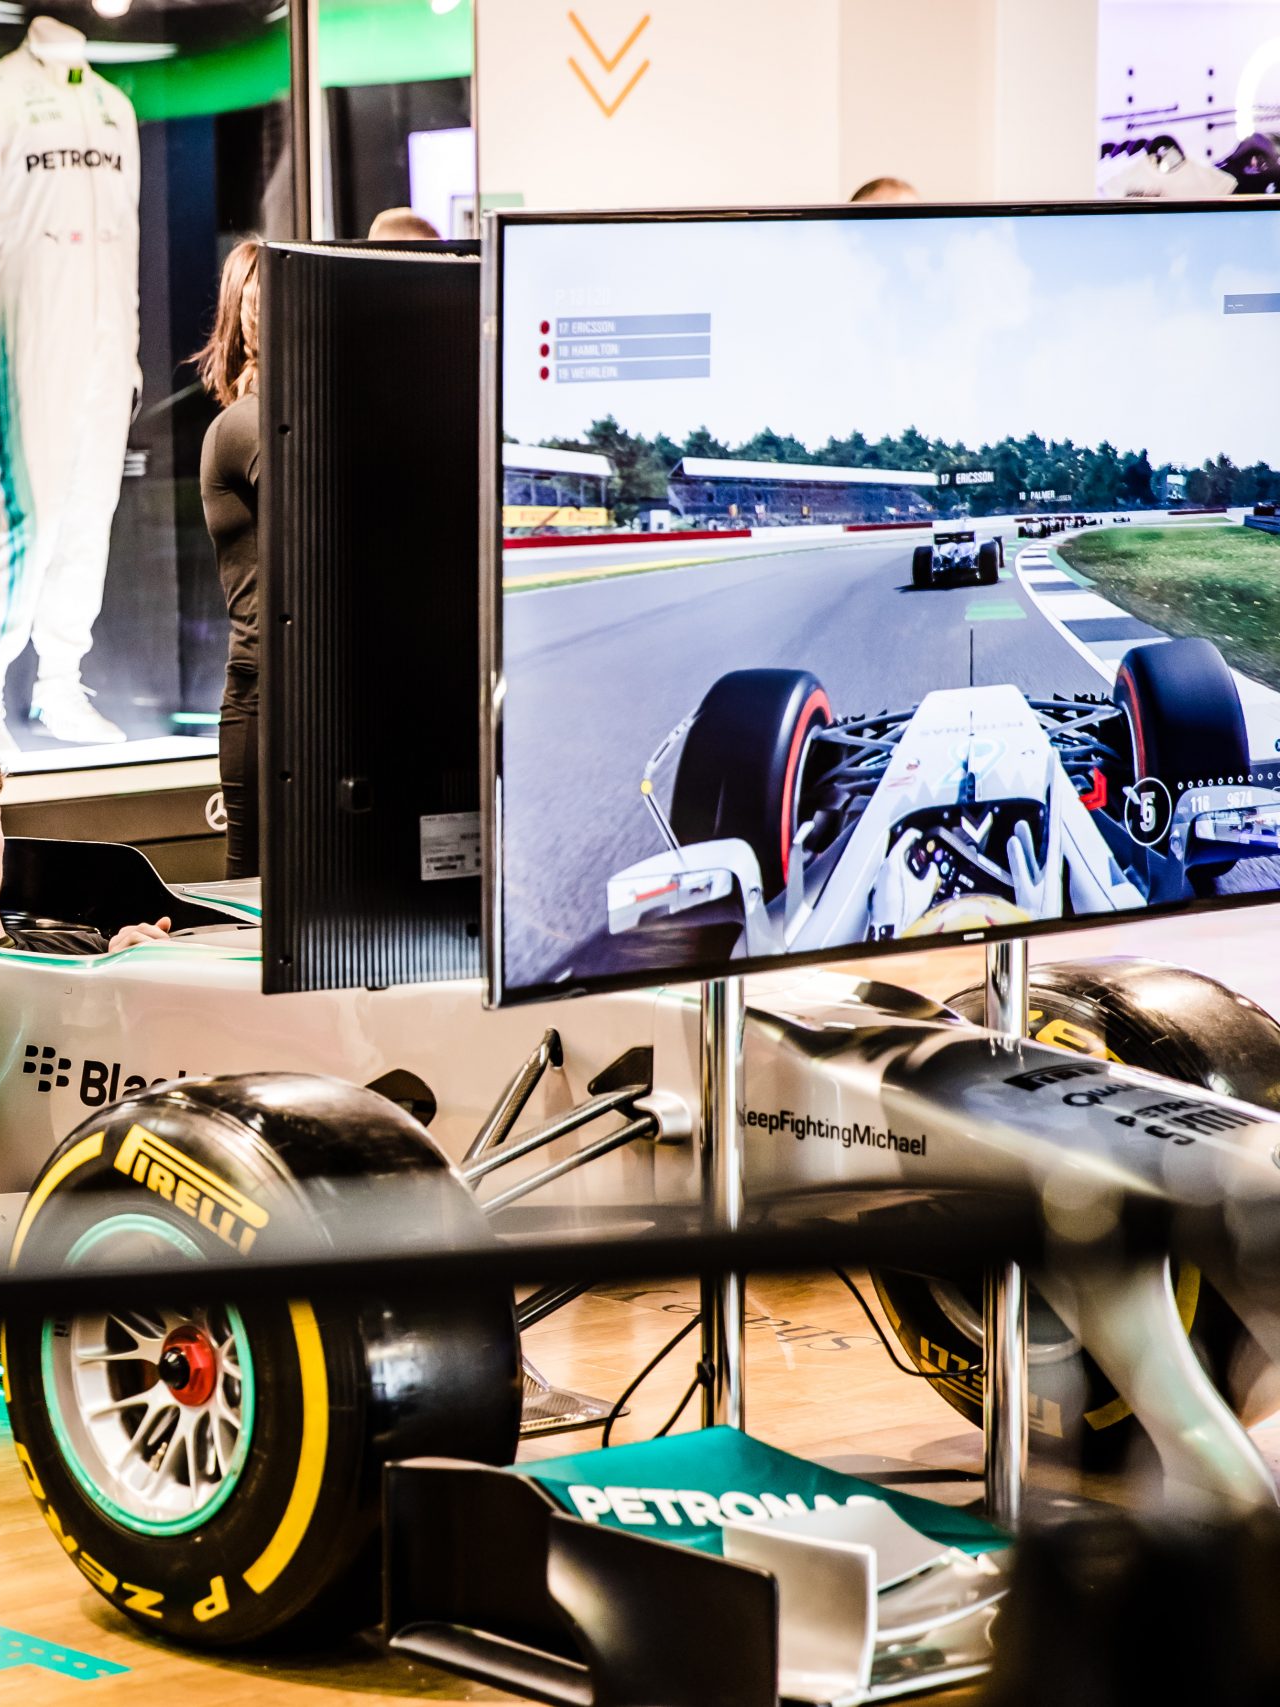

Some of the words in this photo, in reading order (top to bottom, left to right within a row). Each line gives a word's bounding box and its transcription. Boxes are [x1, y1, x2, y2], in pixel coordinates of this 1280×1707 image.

[571, 320, 616, 335] ERICSSON
[571, 343, 619, 357] HAMILTON
[571, 365, 619, 379] WEHRLEIN
[940, 474, 950, 485] 17
[955, 471, 995, 485] ERICSSON
[1030, 489, 1056, 500] PALMER
[743, 1104, 927, 1157] eepFightingMichael
[113, 1123, 270, 1257] PIRELLI
[567, 1484, 878, 1526] PETRON
[192, 1574, 230, 1624] P
